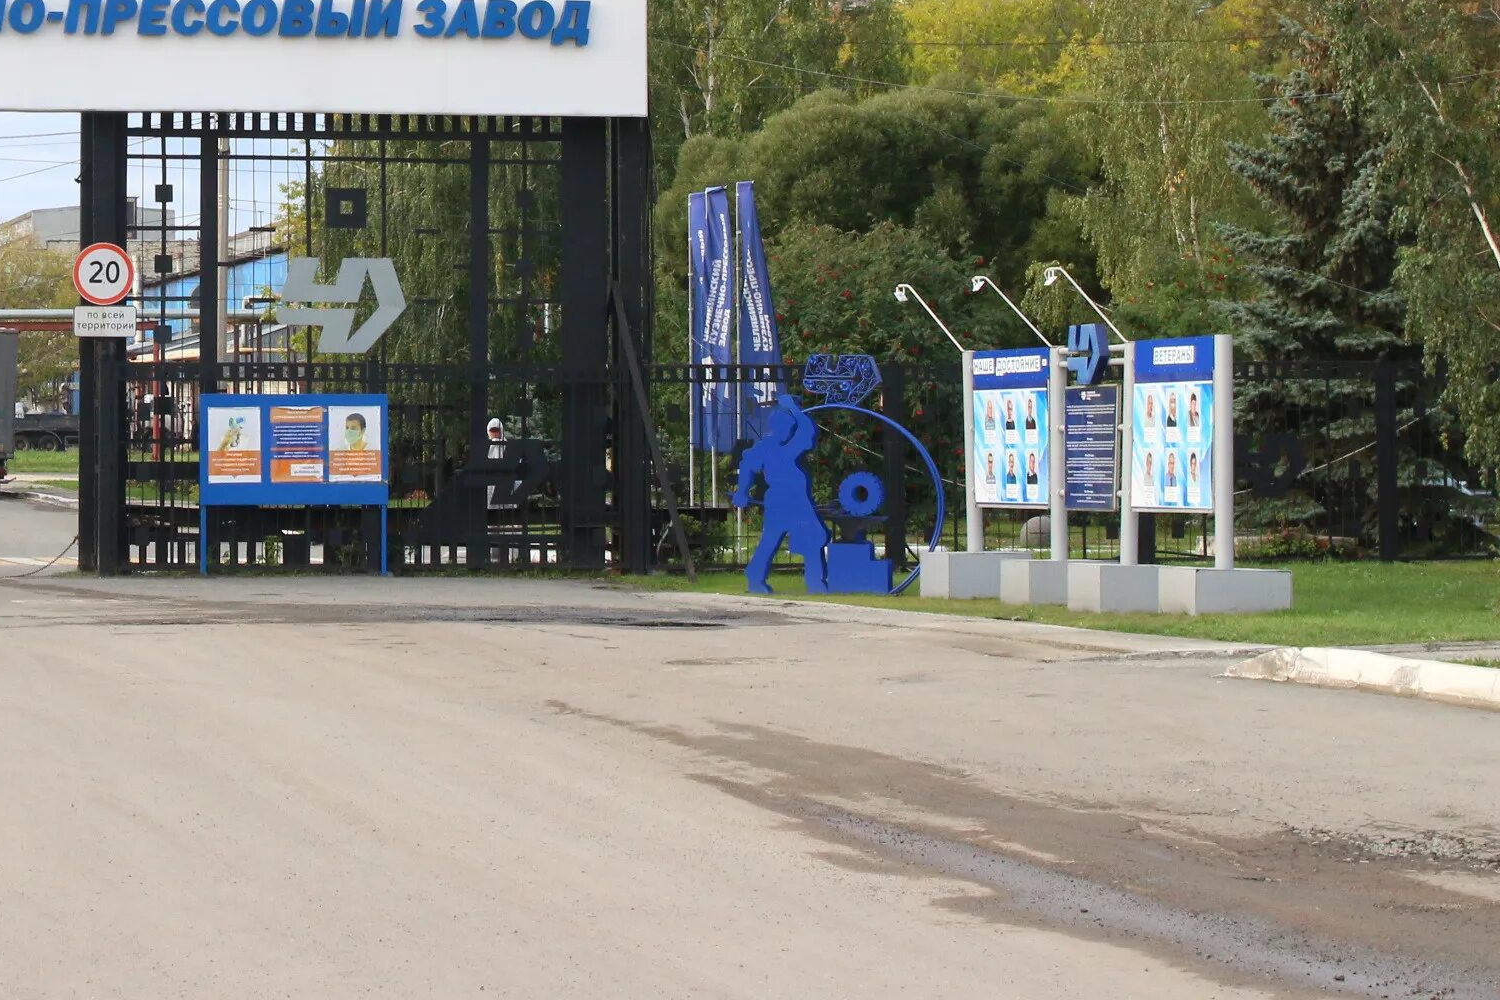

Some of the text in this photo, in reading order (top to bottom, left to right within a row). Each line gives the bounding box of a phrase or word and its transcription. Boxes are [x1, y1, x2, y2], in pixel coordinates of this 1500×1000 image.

[88, 260, 120, 284] 20
[87, 311, 99, 320] по
[76, 322, 135, 332] территории
[719, 308, 731, 347] ЗАВОД
[1154, 347, 1193, 363] ВЕТЕРАНЫ
[996, 357, 1040, 374] ДОСТОЯНИЕ
